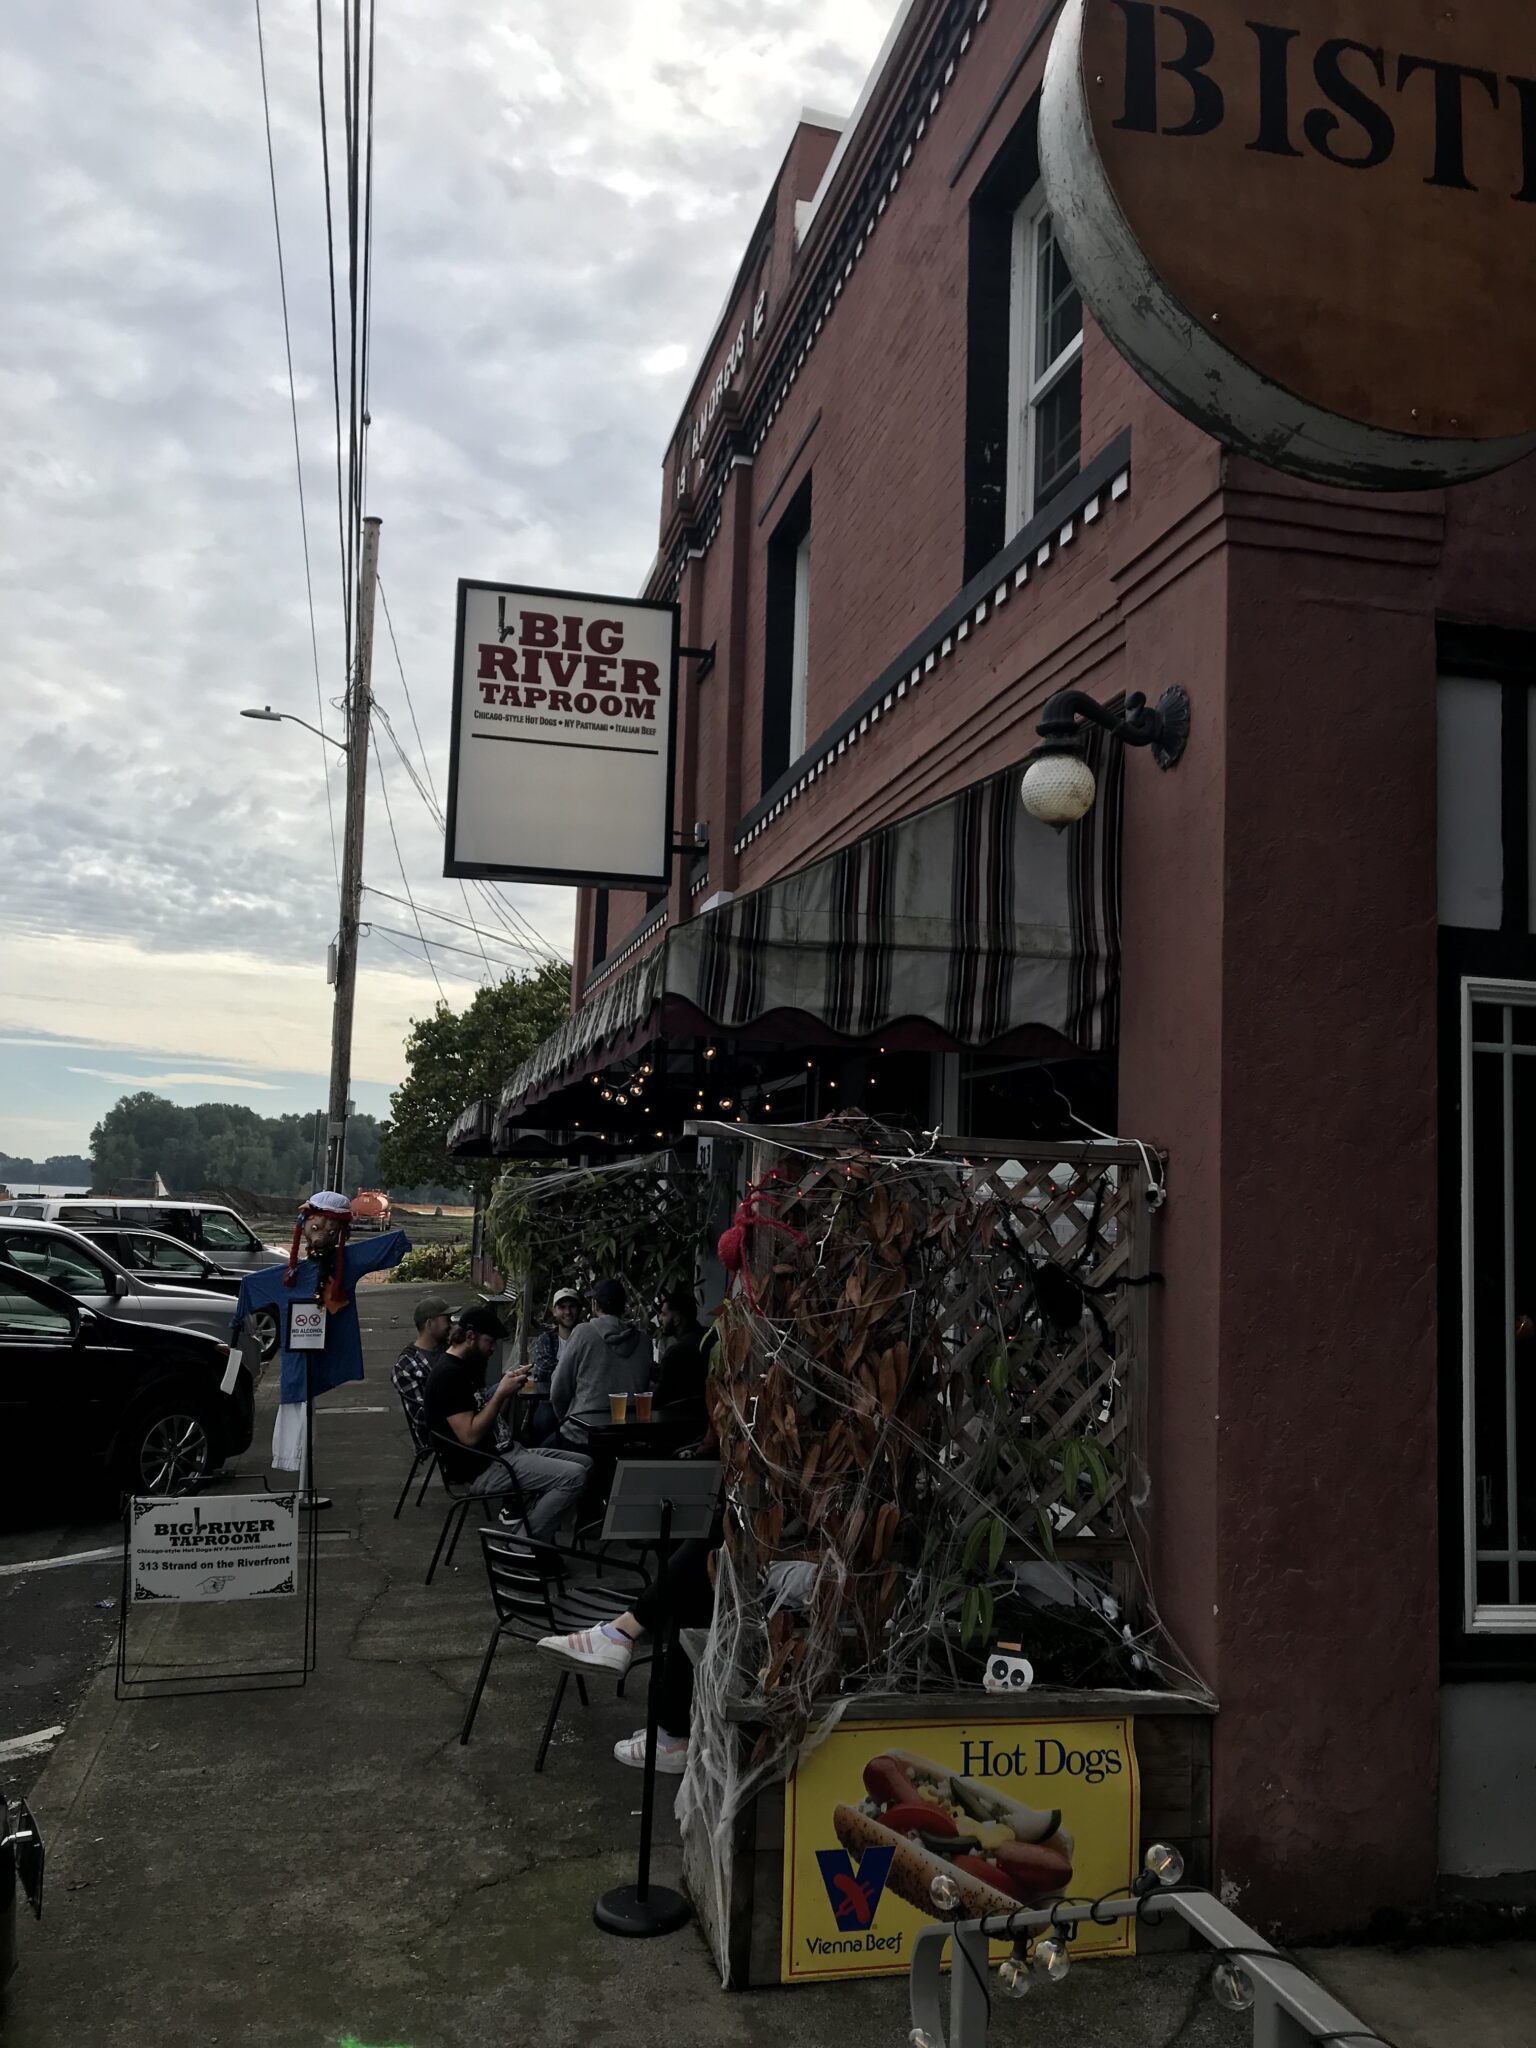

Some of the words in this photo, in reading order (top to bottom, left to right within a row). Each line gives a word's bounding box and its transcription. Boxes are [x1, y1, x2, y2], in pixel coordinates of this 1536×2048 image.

[1100, 0, 1536, 202] BIST
[518, 610, 625, 655] BIG
[477, 643, 661, 696] RIVER
[479, 682, 656, 719] TAPROOM
[564, 719, 574, 728] NY
[154, 1523, 193, 1536] BIG
[207, 1519, 275, 1534] RIVER
[169, 1533, 260, 1547] TAPROOM
[138, 1562, 159, 1571] 313
[162, 1561, 197, 1571] Strand
[217, 1559, 234, 1569] the
[237, 1556, 290, 1568] Riverfront
[960, 1740, 1028, 1778] Hot
[1035, 1739, 1122, 1784] Dogs
[806, 1937, 863, 1955] Vienna
[866, 1932, 903, 1953] Beef
